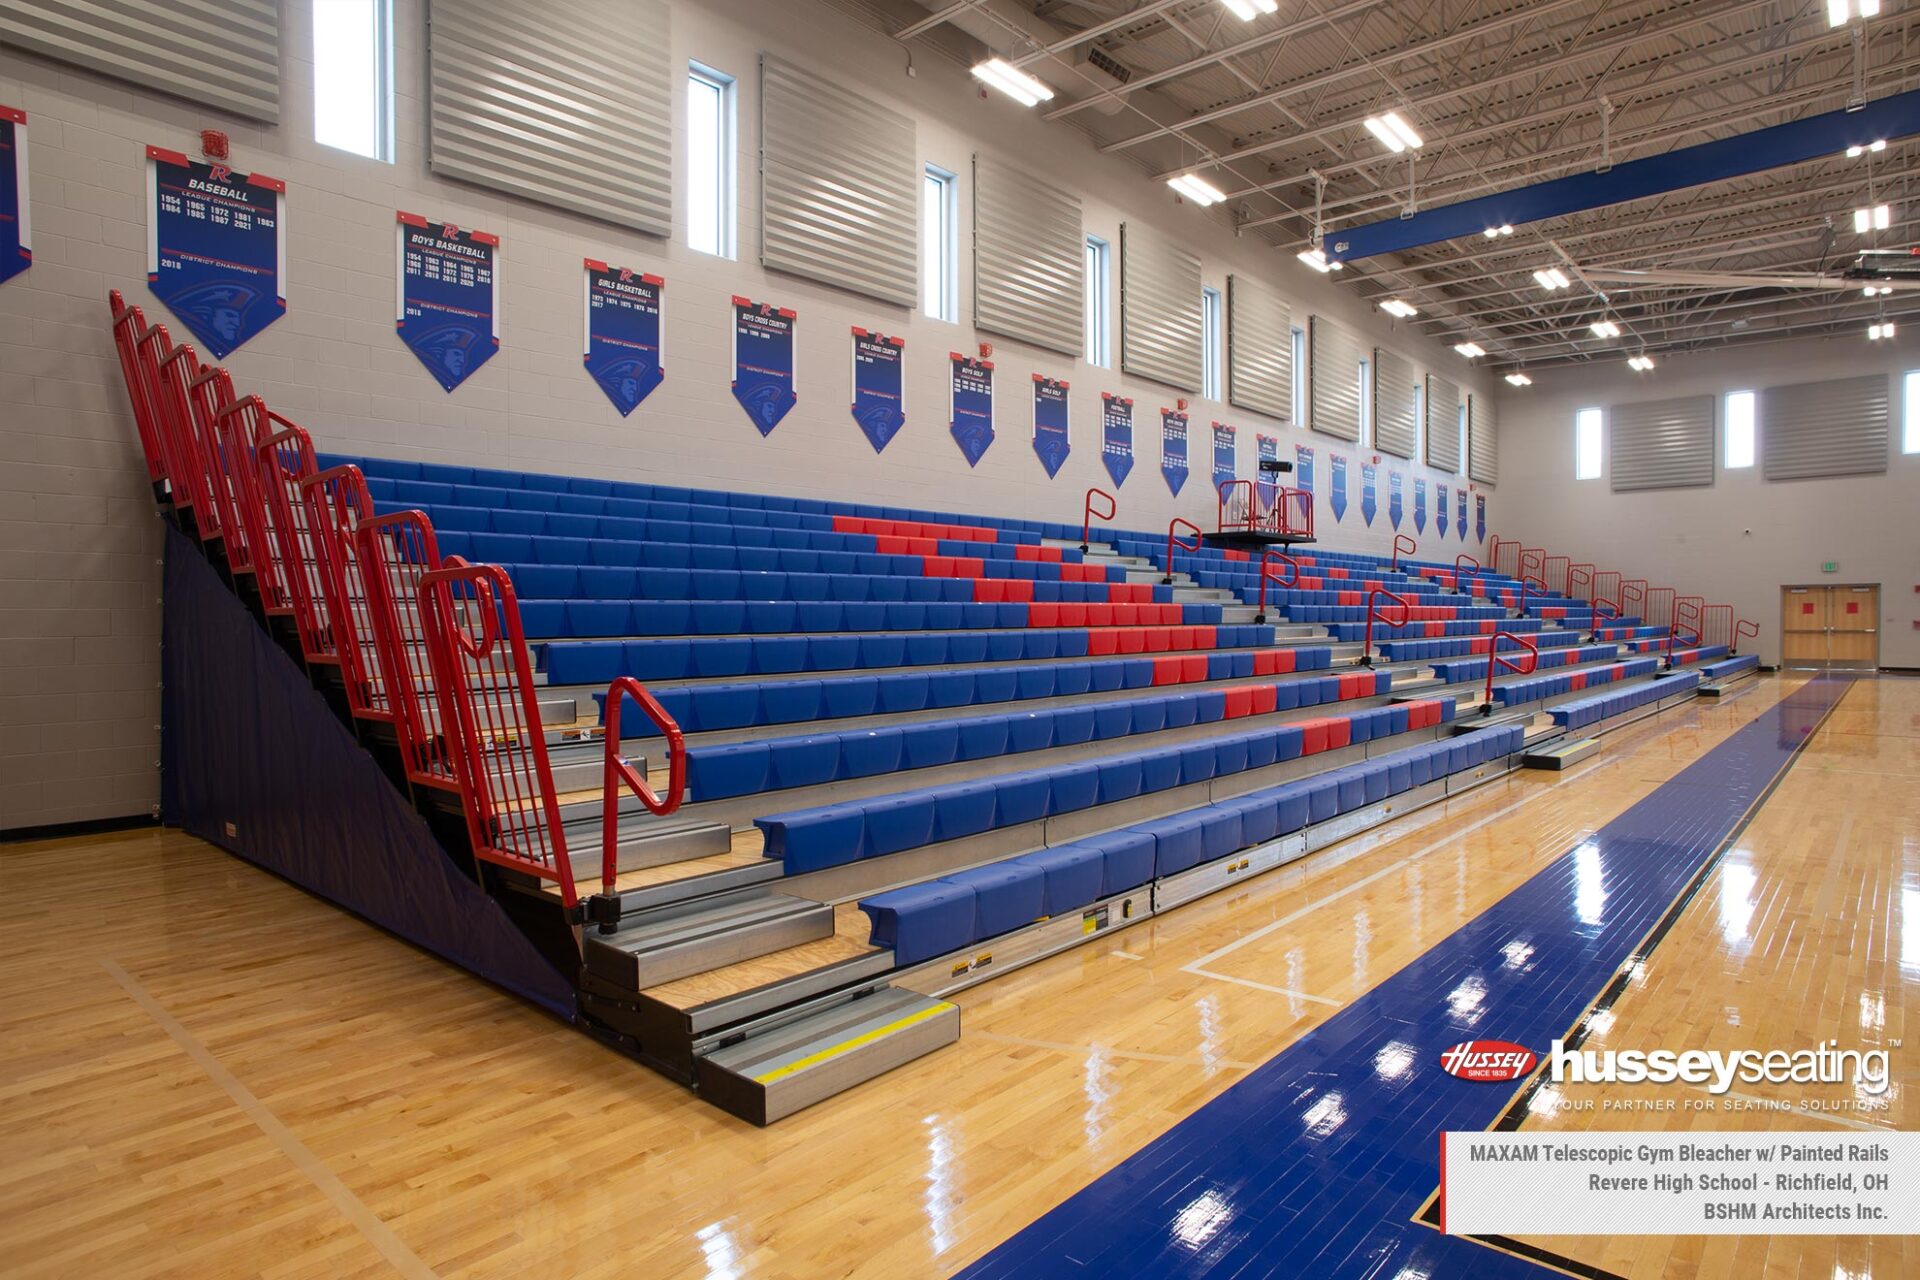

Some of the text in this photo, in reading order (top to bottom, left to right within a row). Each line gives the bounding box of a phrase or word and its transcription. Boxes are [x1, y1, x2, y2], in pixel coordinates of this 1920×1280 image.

[208, 161, 232, 184] R
[188, 179, 248, 201] BASEBALL
[161, 194, 181, 205] 1954
[211, 206, 229, 217] 1972
[182, 191, 255, 212] LEAGUE CHAMPIONS
[234, 220, 251, 230] 2021
[442, 222, 459, 240] R
[411, 234, 485, 259] BOYS BASKETBALL
[161, 259, 181, 270] 2018
[180, 254, 258, 275] DISTRICT CHAMPIONS
[598, 278, 651, 298] GIRLS BASKETBALL
